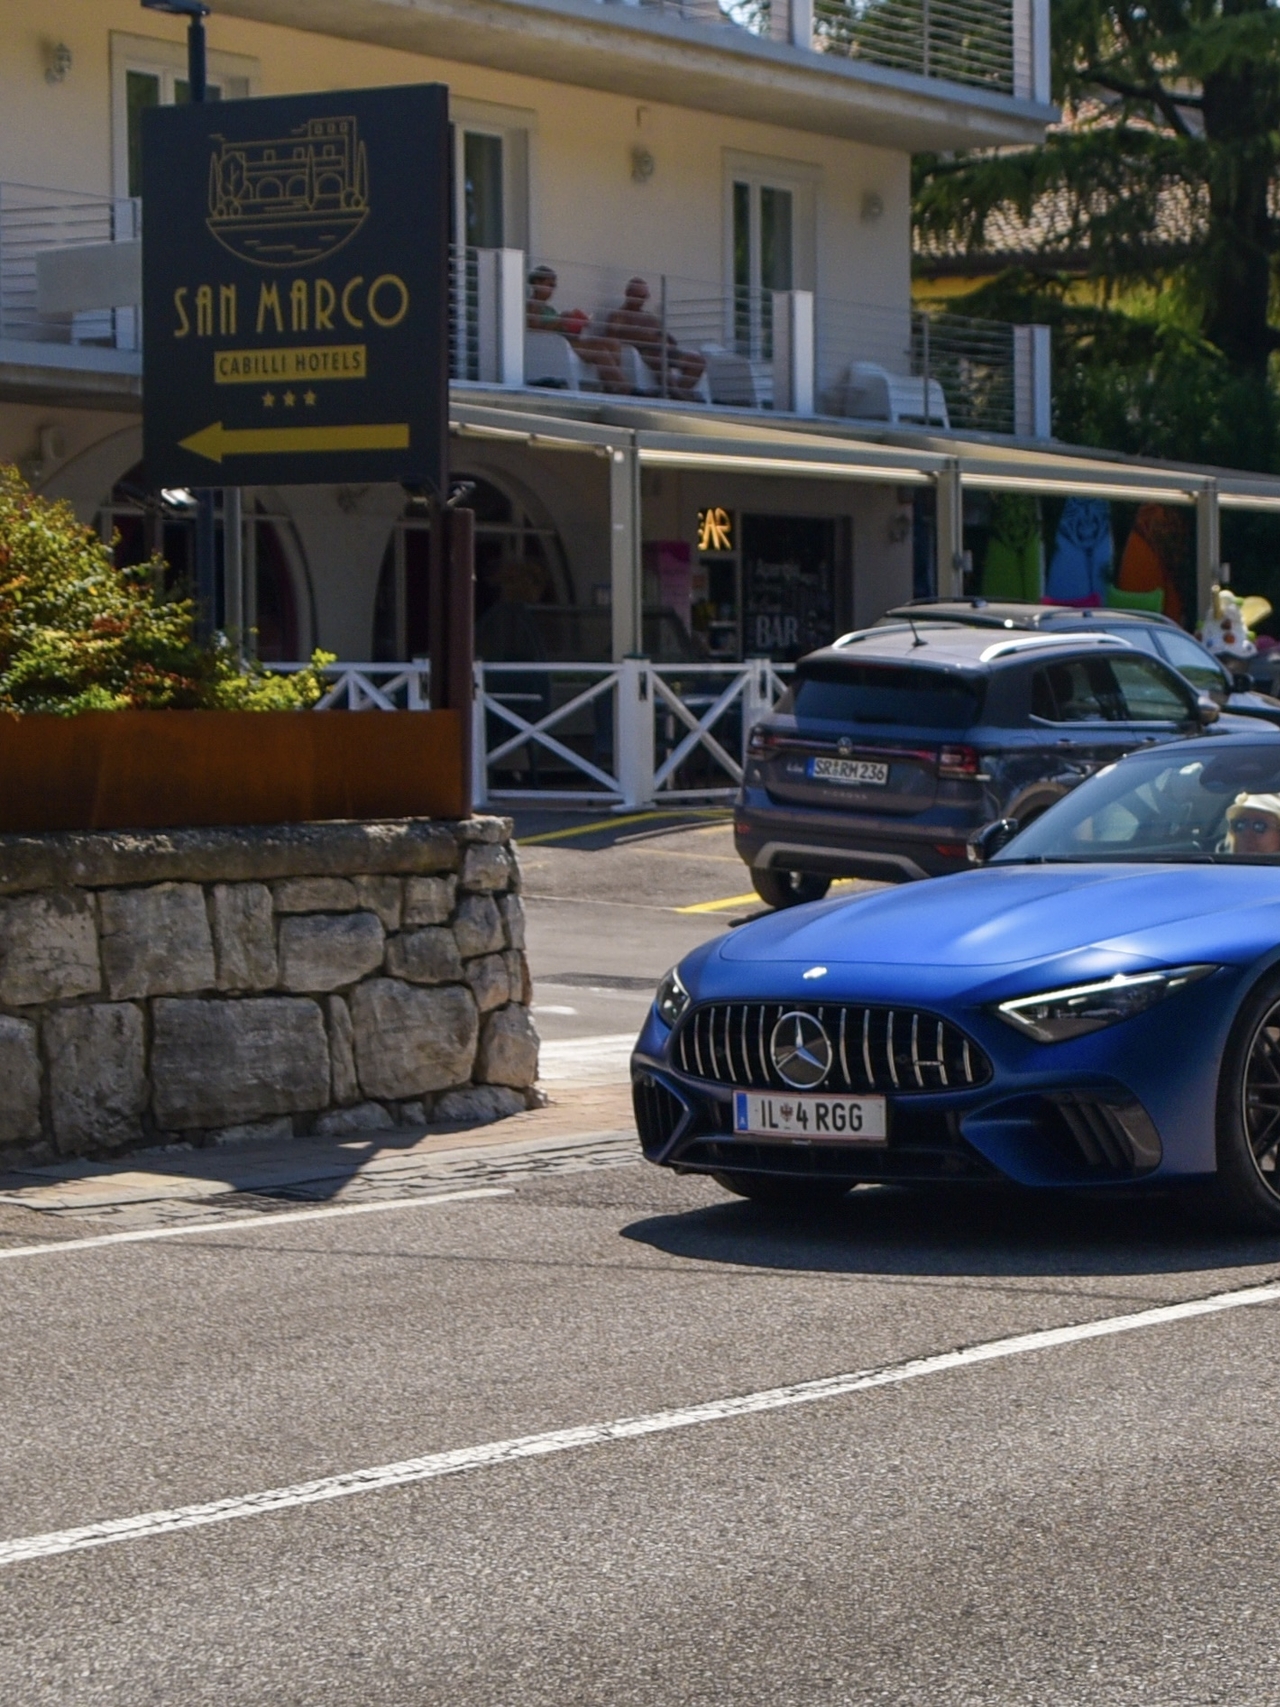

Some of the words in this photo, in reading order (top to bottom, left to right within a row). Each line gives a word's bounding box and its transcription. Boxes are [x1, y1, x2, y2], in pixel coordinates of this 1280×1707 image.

[174, 283, 237, 338] SAN
[256, 273, 410, 334] MARCO
[218, 354, 287, 377] CABILLI
[295, 351, 362, 372] HOTELS
[756, 614, 799, 648] BAR
[815, 760, 832, 776] SR
[860, 764, 885, 781] 236
[796, 1101, 809, 1130] 4
[815, 1102, 863, 1132] RGG
